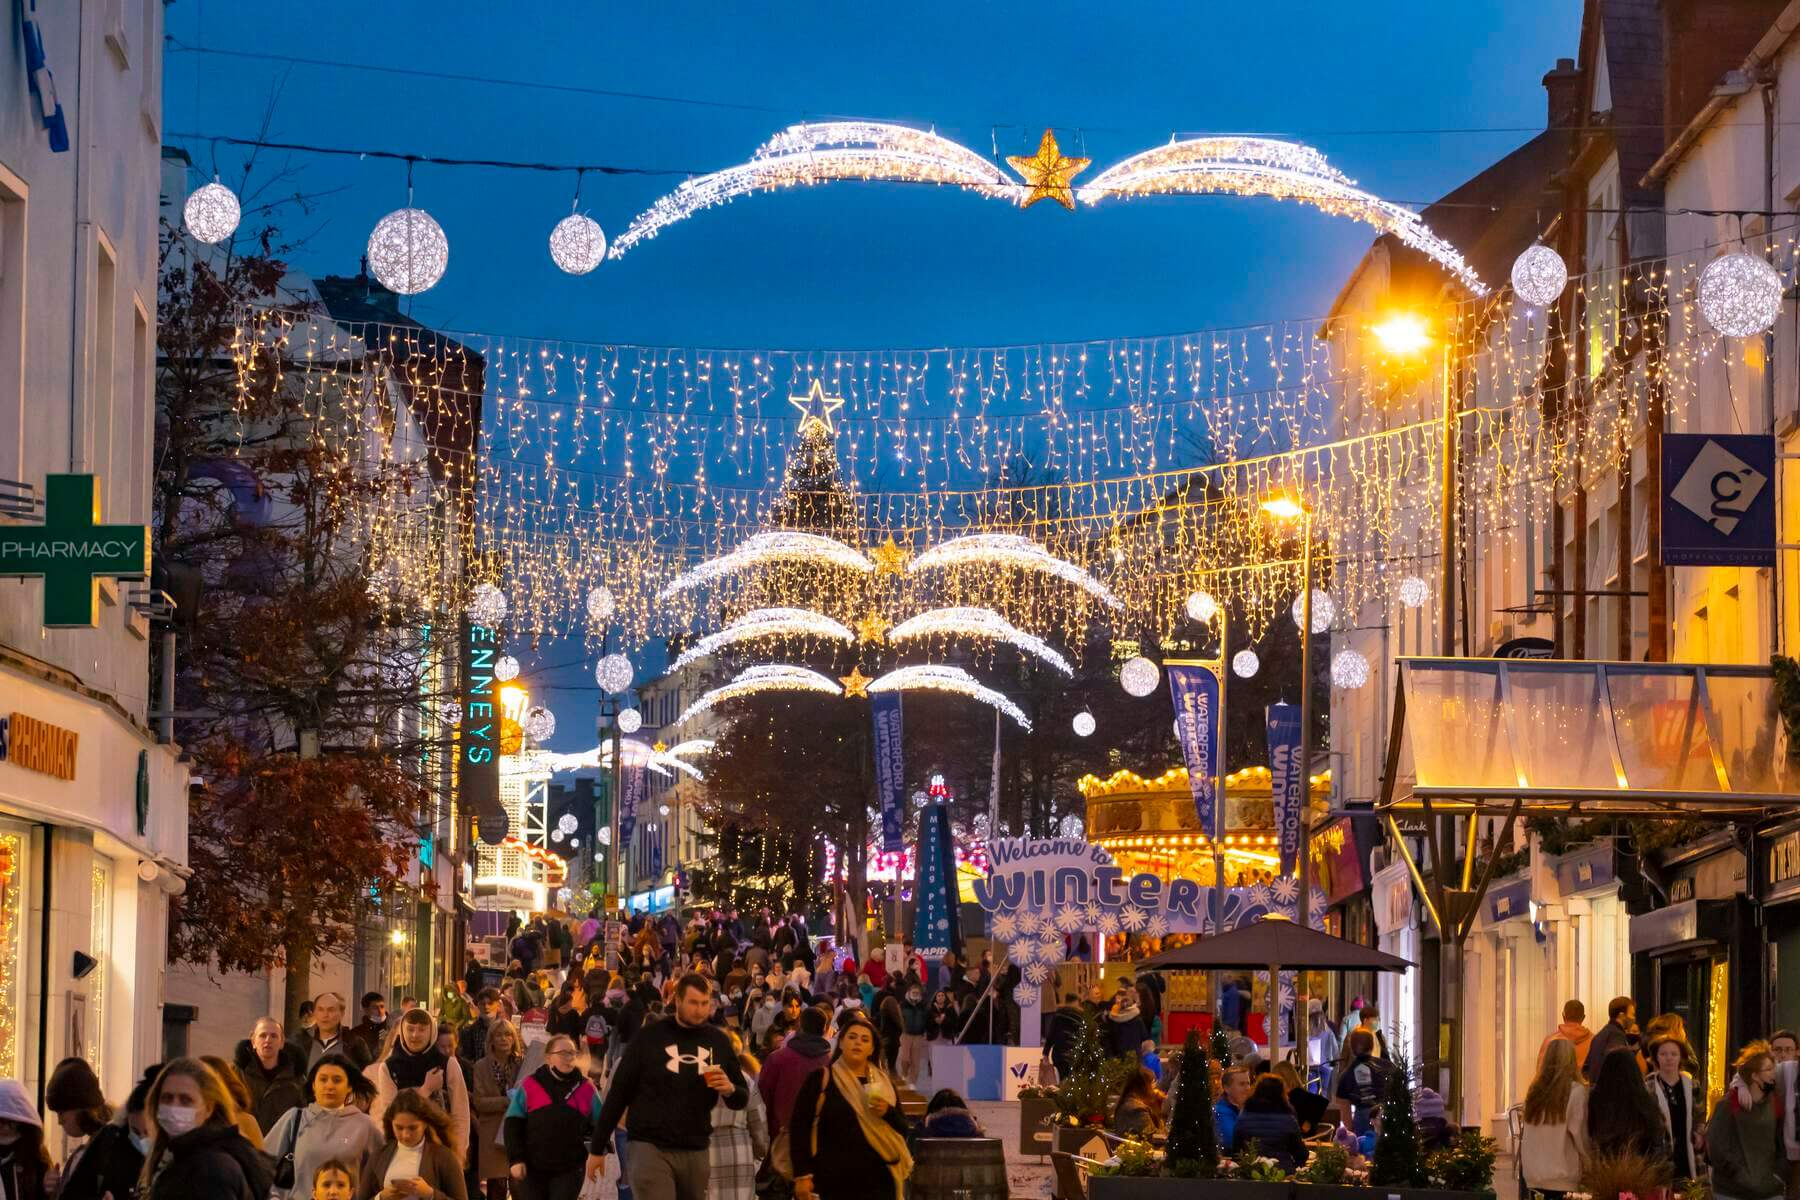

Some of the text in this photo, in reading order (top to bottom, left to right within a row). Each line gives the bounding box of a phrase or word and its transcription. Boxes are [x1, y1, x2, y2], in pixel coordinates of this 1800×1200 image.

[2, 540, 138, 558] PHARMACY
[467, 624, 495, 765] ENNEYS
[9, 711, 78, 781] PHARMACY
[989, 837, 1114, 865] Welcome to
[927, 815, 938, 940] Meeting Point
[914, 947, 948, 956] RAPID
